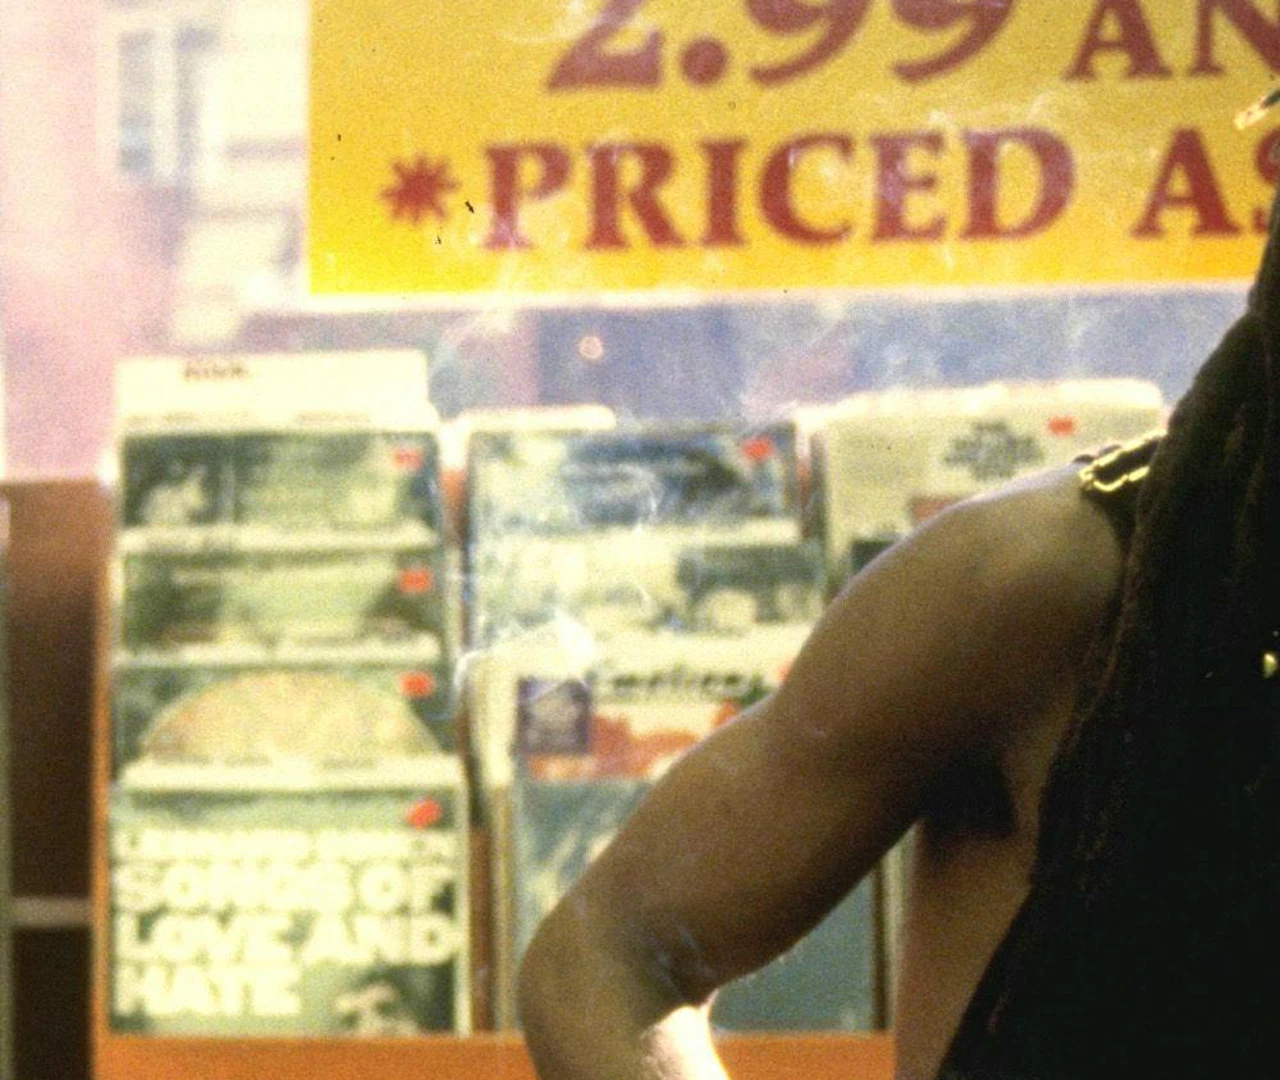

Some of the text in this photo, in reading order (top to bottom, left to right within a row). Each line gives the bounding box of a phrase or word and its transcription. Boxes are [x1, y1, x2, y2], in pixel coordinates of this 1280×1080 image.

[481, 124, 1077, 252] PRICED
[118, 914, 456, 962] LOVE AND
[118, 966, 301, 1014] HATE
